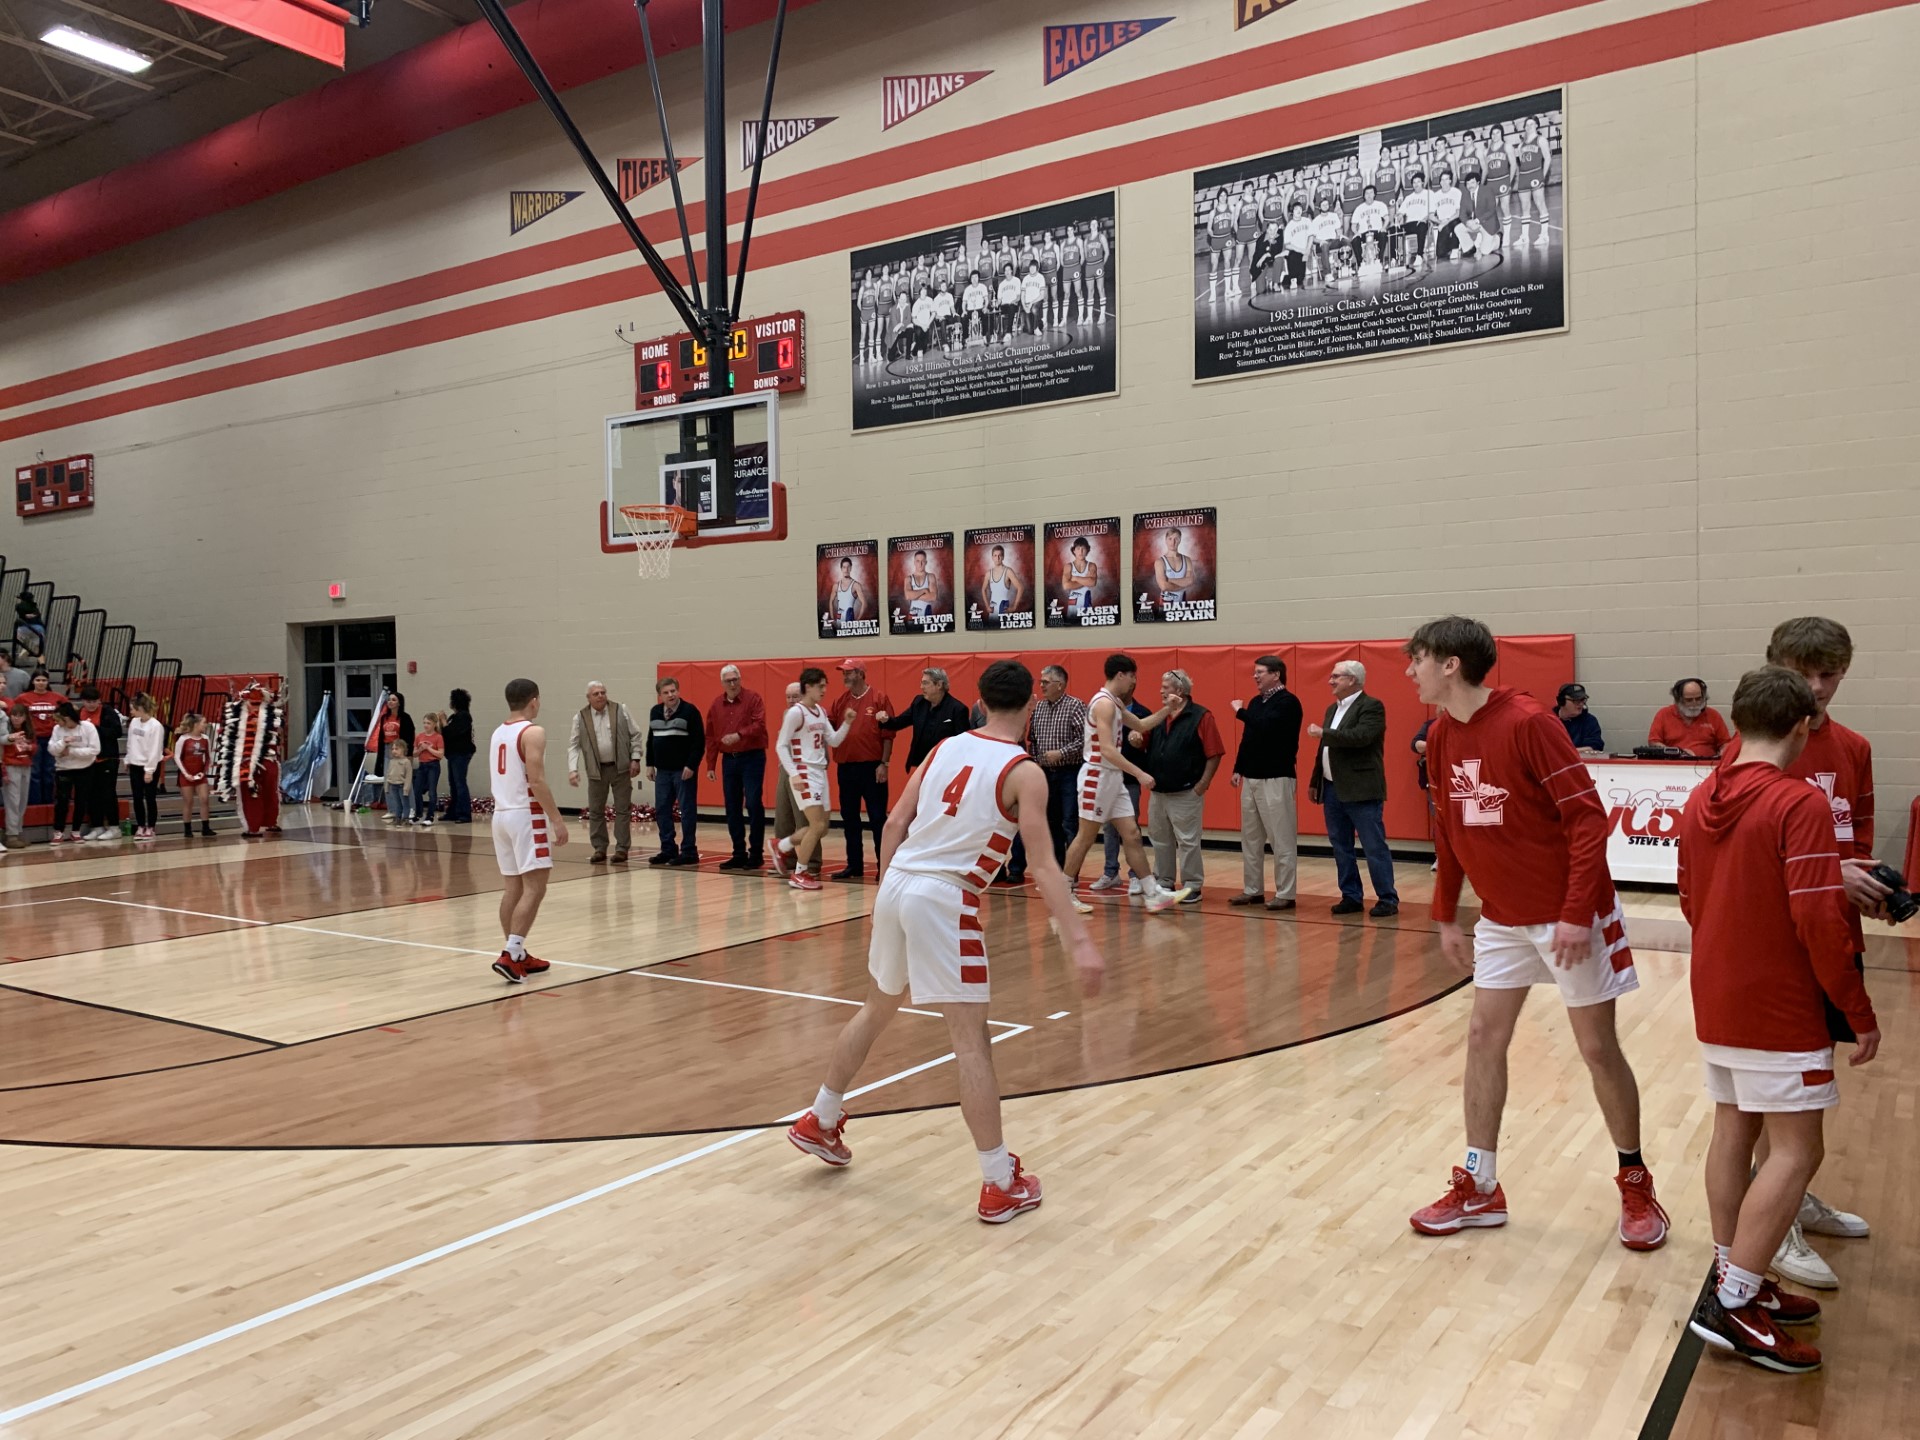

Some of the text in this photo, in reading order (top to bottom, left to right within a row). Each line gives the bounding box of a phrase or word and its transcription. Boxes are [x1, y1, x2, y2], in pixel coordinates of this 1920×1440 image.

[1051, 21, 1141, 79] EAGLES
[886, 74, 965, 125] INDIANS
[745, 118, 816, 167] MROONS
[513, 192, 566, 231] WARRIORS
[1270, 280, 1479, 322] 1983 Illinois Class A State Champions
[1210, 334, 1224, 342] Row
[1243, 328, 1257, 337] Bob
[1258, 323, 1293, 334] Kirkwood,
[1294, 319, 1323, 330] Manager
[1325, 316, 1338, 324] Tim
[1340, 311, 1377, 322] Seitzinger,
[1378, 307, 1394, 315] Asst
[1395, 301, 1418, 312] Coach
[1420, 299, 1446, 309] George
[1448, 294, 1478, 304] Grubbs,
[1480, 289, 1499, 299] Head
[1501, 284, 1525, 295] Coach
[1527, 283, 1544, 292] Ron
[755, 318, 796, 338] VISITOR
[1253, 337, 1267, 346] Asst
[1268, 333, 1289, 343] Coach
[1290, 330, 1306, 339] Rick
[1334, 322, 1360, 332] Student
[1362, 317, 1384, 328] Coach
[1385, 315, 1405, 325] Steve
[1436, 305, 1463, 316] Trainer
[1465, 302, 1485, 312] Mike
[1486, 297, 1522, 309] Goodwin
[1219, 353, 1233, 361] Row
[1243, 349, 1253, 357] Jay
[1277, 341, 1296, 351] Darin
[1317, 336, 1331, 345] Jeff
[1356, 329, 1376, 340] Keith
[1409, 323, 1429, 331] Dave
[1458, 314, 1474, 323] Tim
[1509, 306, 1533, 316] Marty
[1269, 352, 1287, 362] Chris
[1326, 345, 1345, 354] Ernie
[1365, 339, 1378, 348] Bill
[1414, 331, 1433, 341] Mike
[1475, 322, 1490, 332] Jeff
[1491, 320, 1511, 329] Gher
[642, 343, 669, 360] HOME
[778, 338, 792, 369] 0
[905, 342, 1051, 375] 1982 Illinois Class A State Champions
[1014, 357, 1033, 365] George
[1055, 349, 1070, 358] Head
[1070, 346, 1088, 355] Coach
[657, 361, 671, 390] 0
[754, 376, 779, 389] BONUS
[653, 394, 677, 406] BONUS
[734, 456, 764, 467] CKET TO
[1144, 514, 1203, 529] WRESTLING
[974, 531, 1024, 544] WRESTLING
[1054, 524, 1107, 538] WRESTLING
[825, 545, 868, 558] WRESTLING
[897, 538, 943, 552] WRESTLING
[1077, 605, 1118, 617] KASEN
[1164, 600, 1215, 611] DALTON
[912, 614, 953, 624] TREVOR
[998, 612, 1033, 621] TYSON
[1081, 615, 1116, 626] OCHS
[1166, 609, 1215, 621] SPAHN
[841, 620, 878, 629] ROBERT
[923, 623, 947, 632] LOY
[1000, 620, 1033, 628] LUCAS
[498, 743, 506, 775] 0
[942, 765, 974, 817] 4
[1628, 836, 1659, 846] STEVE
[1662, 838, 1670, 847] &
